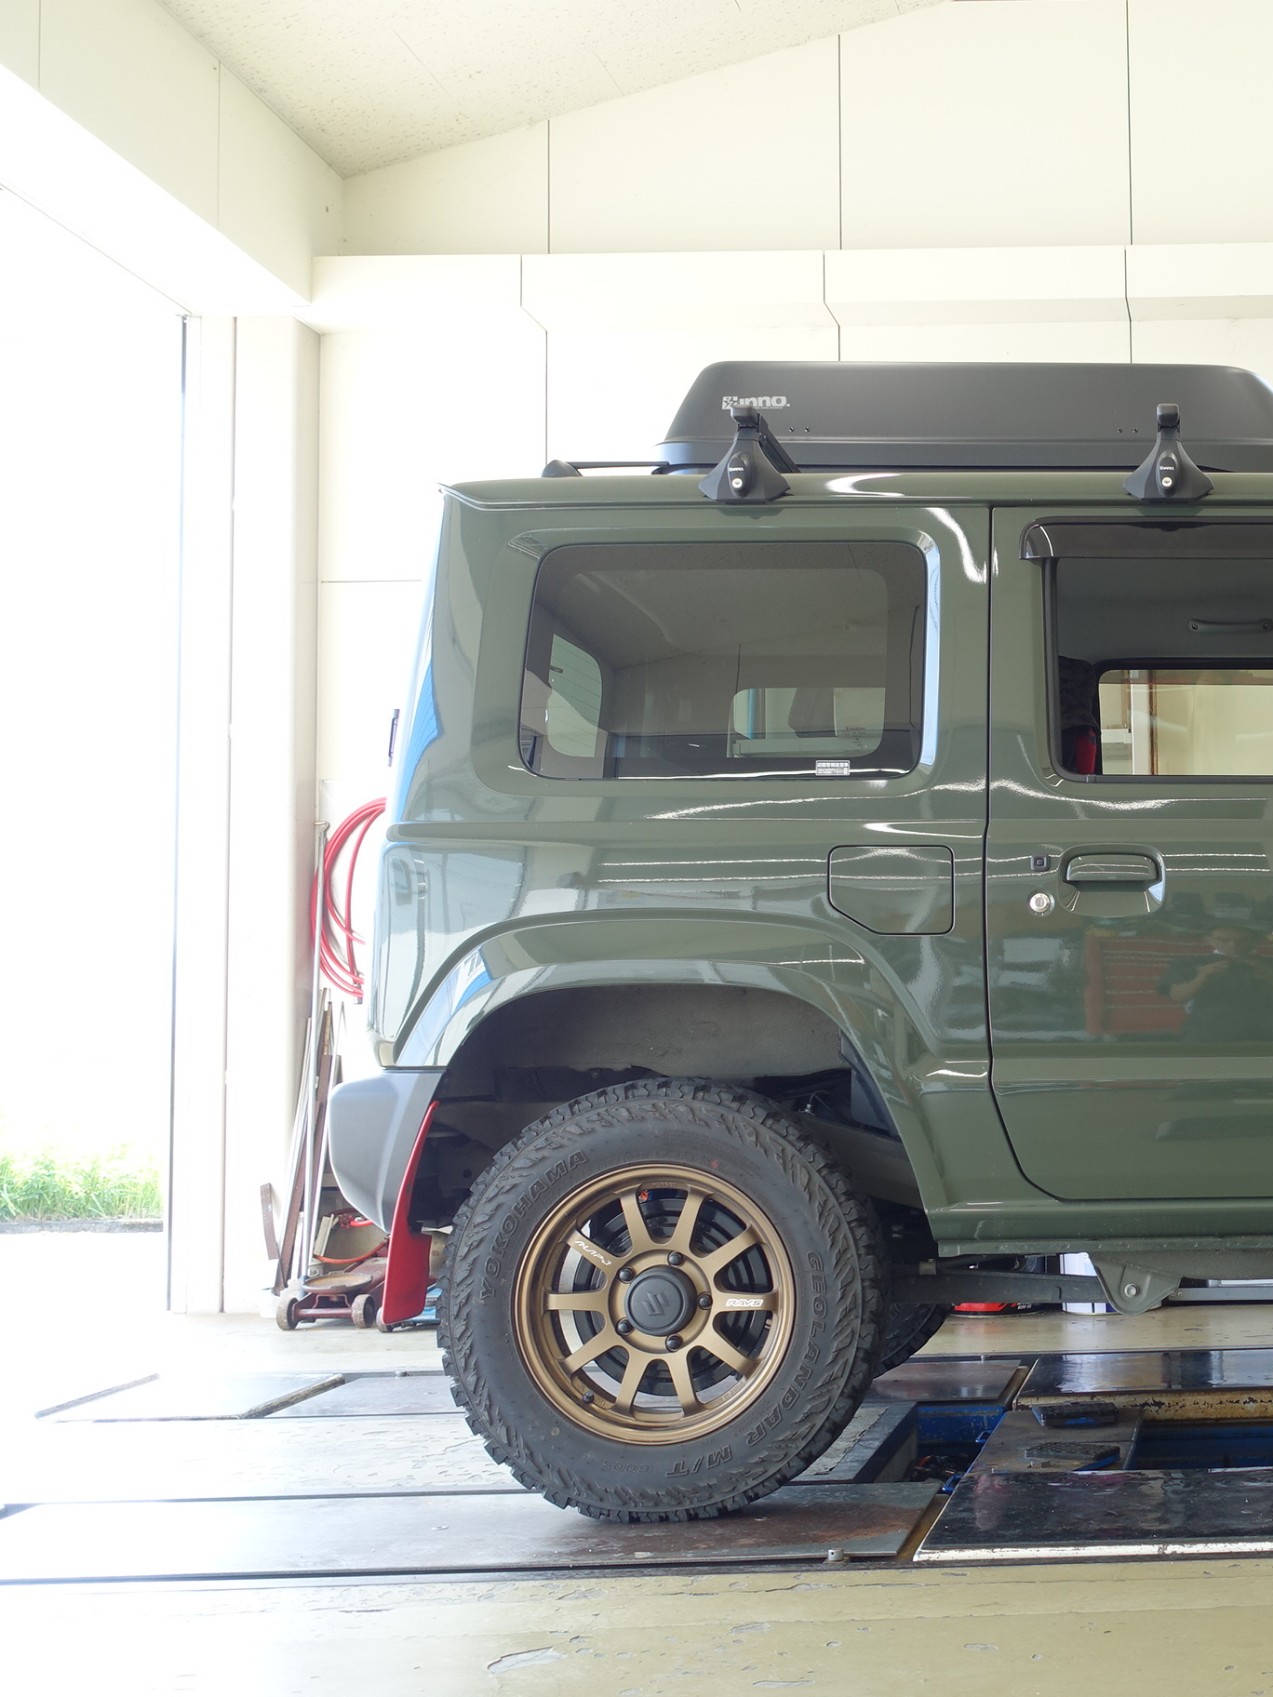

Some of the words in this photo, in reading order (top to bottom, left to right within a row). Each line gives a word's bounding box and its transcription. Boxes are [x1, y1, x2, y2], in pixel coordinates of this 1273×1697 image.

[480, 1150, 588, 1300] YOKOHAMA
[725, 1298, 764, 1307] RAYS
[746, 1251, 827, 1446] GEOLANDAR
[665, 1445, 734, 1478] M/T
